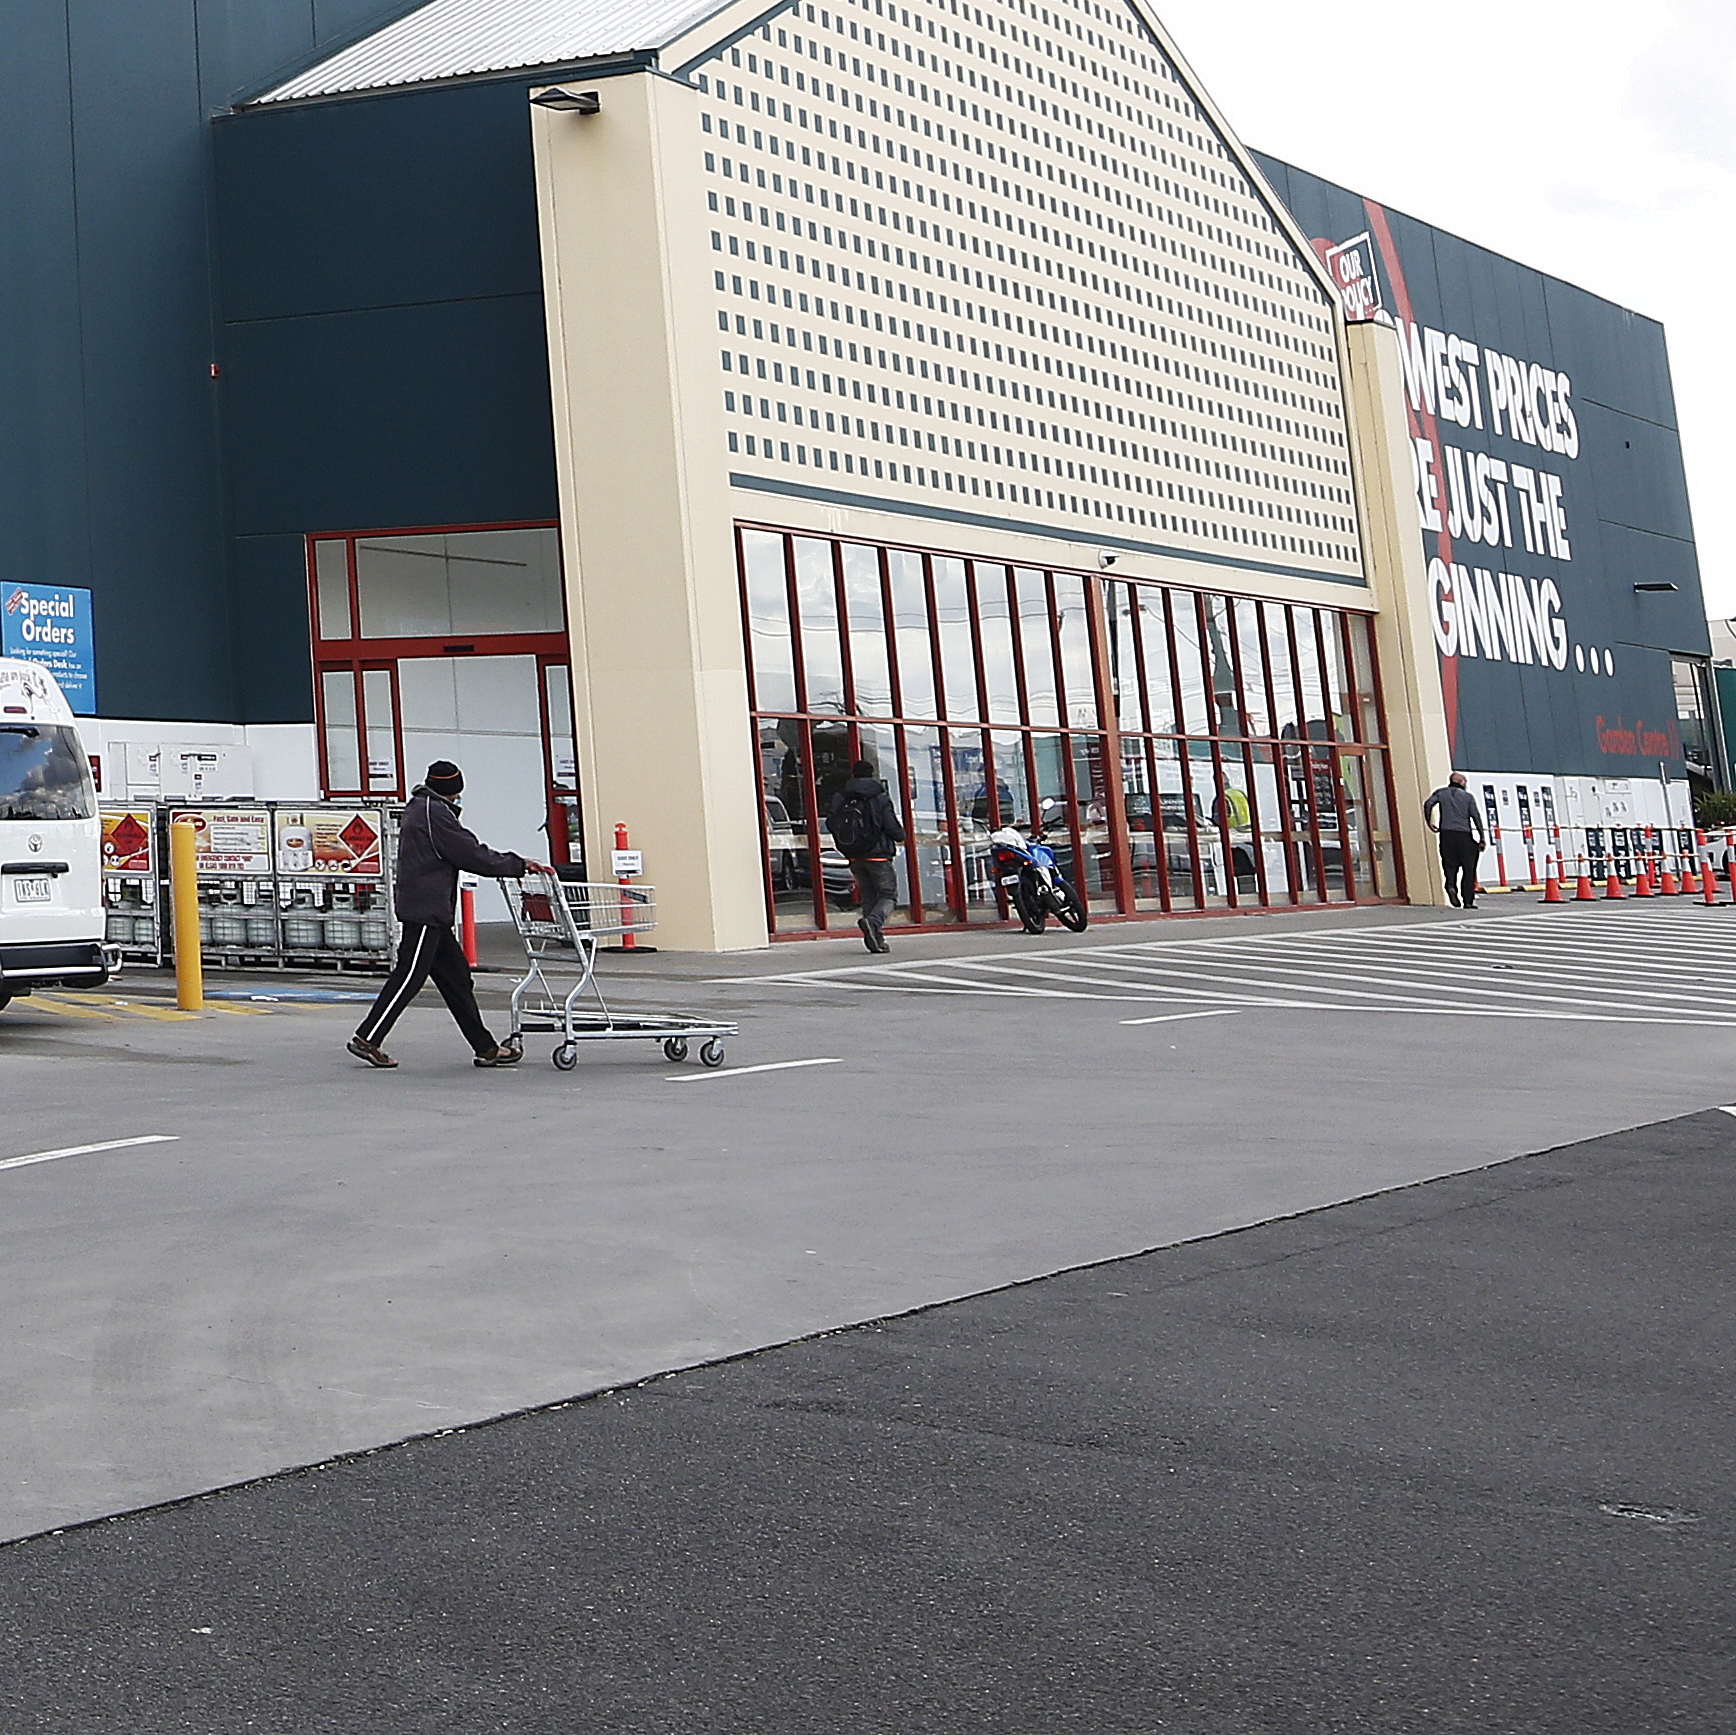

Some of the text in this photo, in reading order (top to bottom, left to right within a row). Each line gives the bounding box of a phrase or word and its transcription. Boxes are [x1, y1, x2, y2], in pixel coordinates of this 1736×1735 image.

[1339, 249, 1364, 283] OUR
[1342, 275, 1374, 312] OLICY
[1484, 348, 1579, 459] PRICES
[1445, 445, 1513, 548] JUST
[1511, 463, 1572, 561] THE
[20, 591, 74, 620] Special
[22, 619, 76, 644] Orders
[54, 658, 68, 669] Desk
